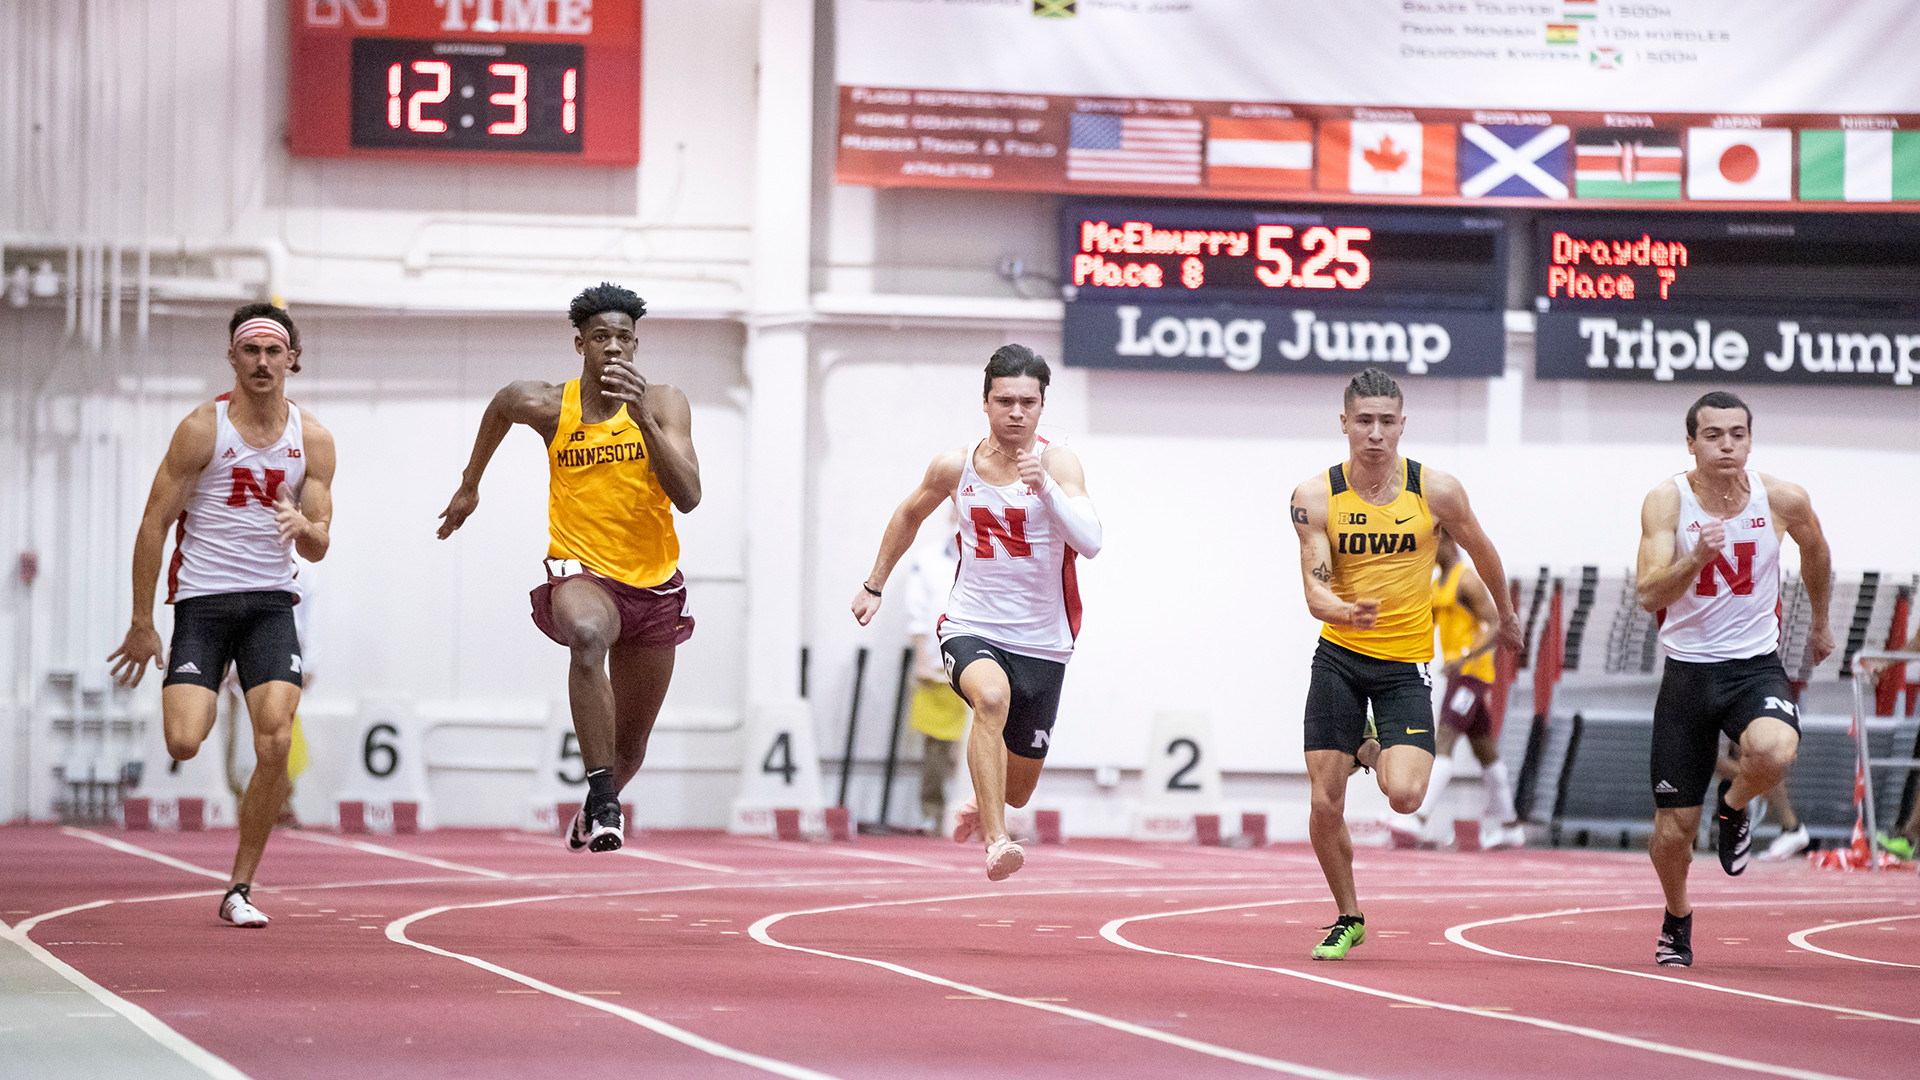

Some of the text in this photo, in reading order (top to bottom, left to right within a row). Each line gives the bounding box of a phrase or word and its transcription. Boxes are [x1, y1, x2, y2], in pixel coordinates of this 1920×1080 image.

[434, 0, 593, 34] TIME
[387, 60, 577, 135] 12:31
[1072, 253, 1205, 290] Place 8
[1254, 223, 1372, 290] 5.25
[1551, 230, 1689, 268] Drayden
[1547, 264, 1677, 301] Place 7
[1116, 305, 1452, 375] Long Jump
[1578, 317, 1750, 382] Triple
[556, 441, 646, 468] MINNESOTA
[226, 467, 286, 508] N
[969, 505, 1034, 560] N
[1337, 532, 1417, 555] IOWA
[1695, 540, 1758, 598] N
[364, 723, 399, 778] 6
[558, 731, 587, 785] 5
[762, 731, 797, 785] 4
[1165, 737, 1204, 792] 2
